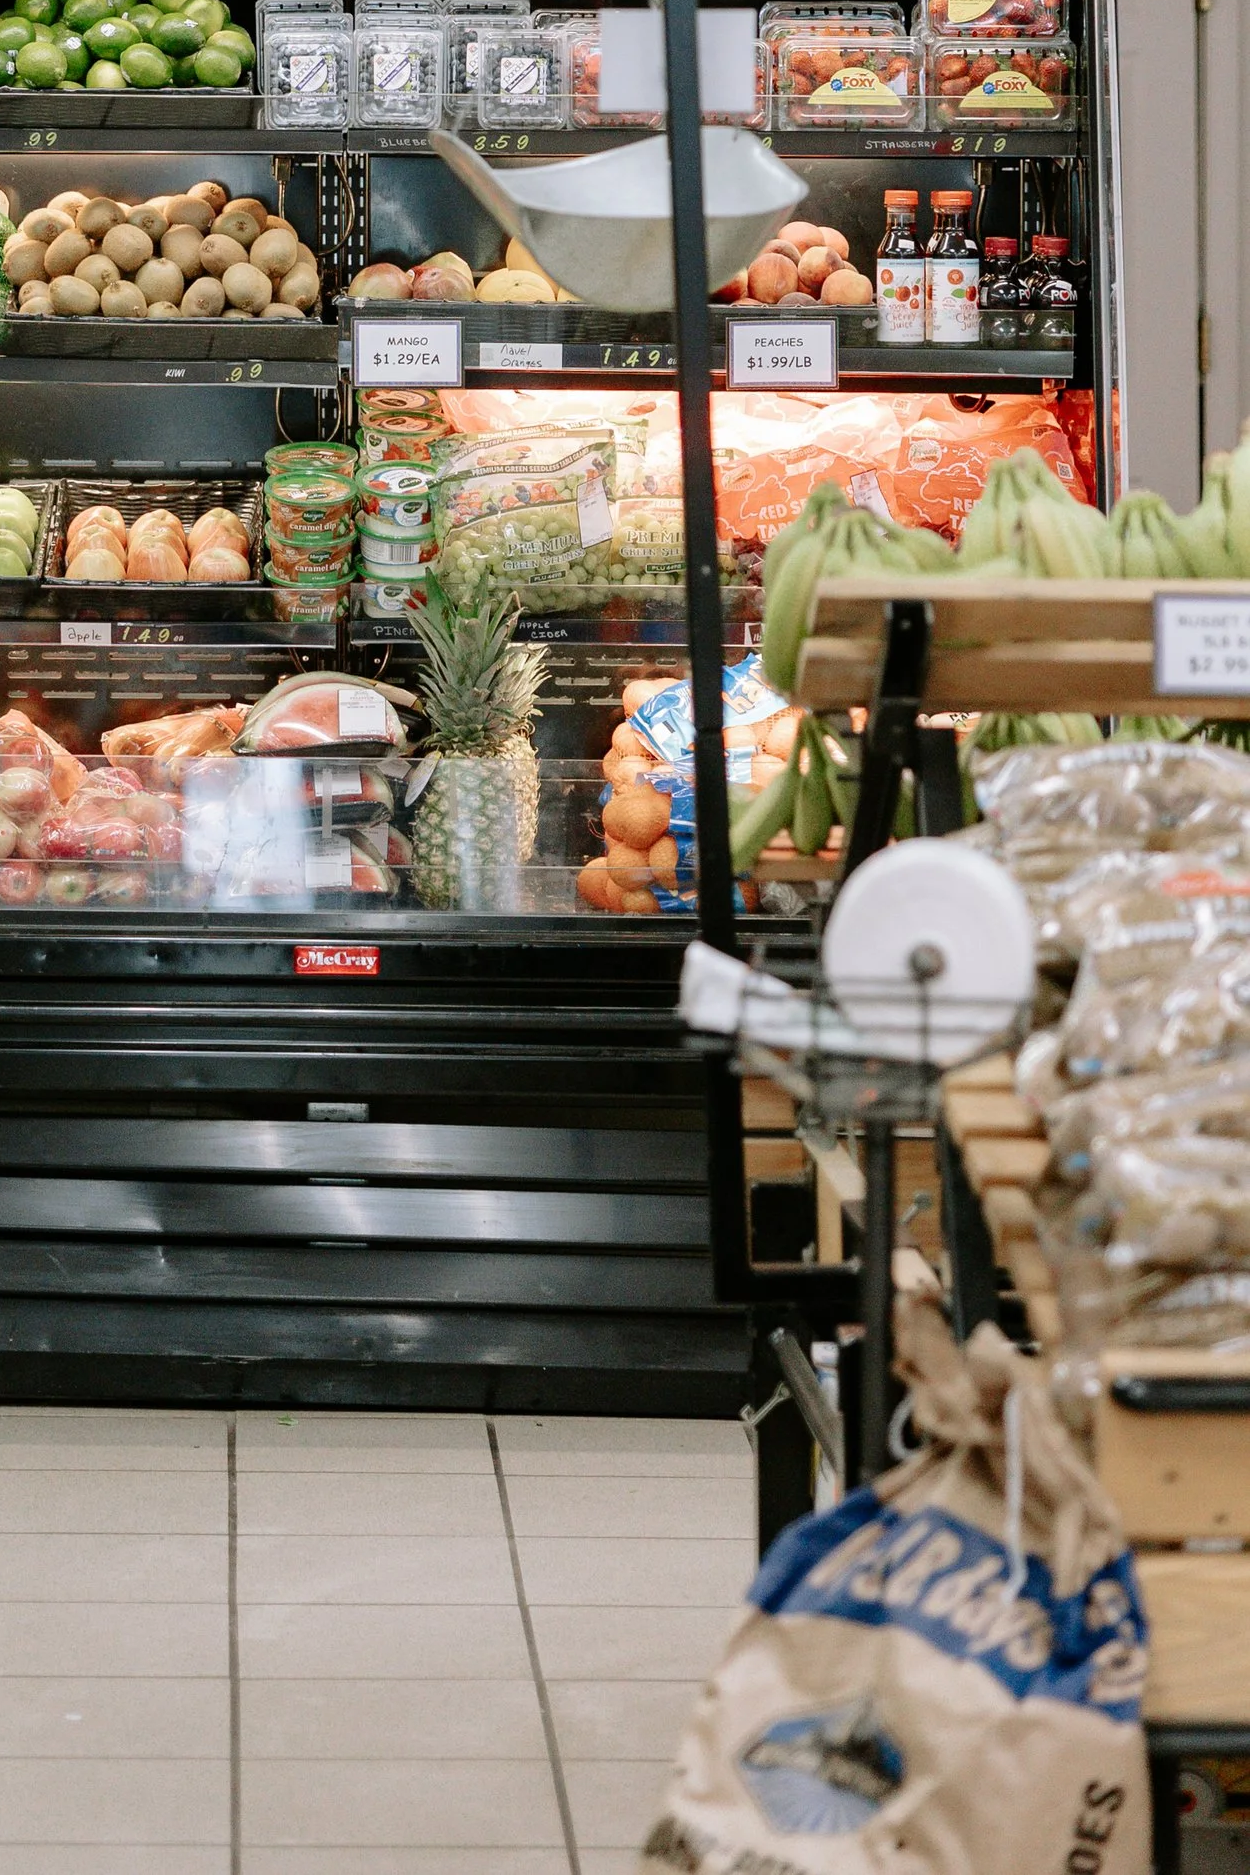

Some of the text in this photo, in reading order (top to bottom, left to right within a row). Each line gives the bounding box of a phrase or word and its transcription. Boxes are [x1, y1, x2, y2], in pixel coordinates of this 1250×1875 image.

[843, 77, 875, 87] FOXY
[995, 80, 1027, 91] FOXY
[378, 135, 530, 152] BLUEBE 3.59
[864, 139, 938, 150] STRAWBERRY
[387, 337, 429, 346] MANGO
[754, 338, 804, 347] PEACHES
[373, 353, 441, 366] $1.29/EA
[601, 346, 661, 367] 1.49
[747, 356, 813, 370] $1.99/LB
[165, 369, 187, 378] KIWI
[471, 464, 504, 476] PREMIUM
[505, 464, 529, 473] GREEN
[758, 505, 788, 521] RED
[289, 522, 337, 532] caramel dip
[626, 531, 686, 544] PREMI
[507, 533, 580, 557] PREMIUM
[295, 563, 342, 573] caramel dip
[287, 605, 321, 614] caramel
[519, 621, 550, 630] APPLE
[121, 626, 170, 643] 1.49
[373, 626, 416, 637] PINEA
[531, 629, 568, 639] CIDER
[297, 951, 378, 970] McCray
